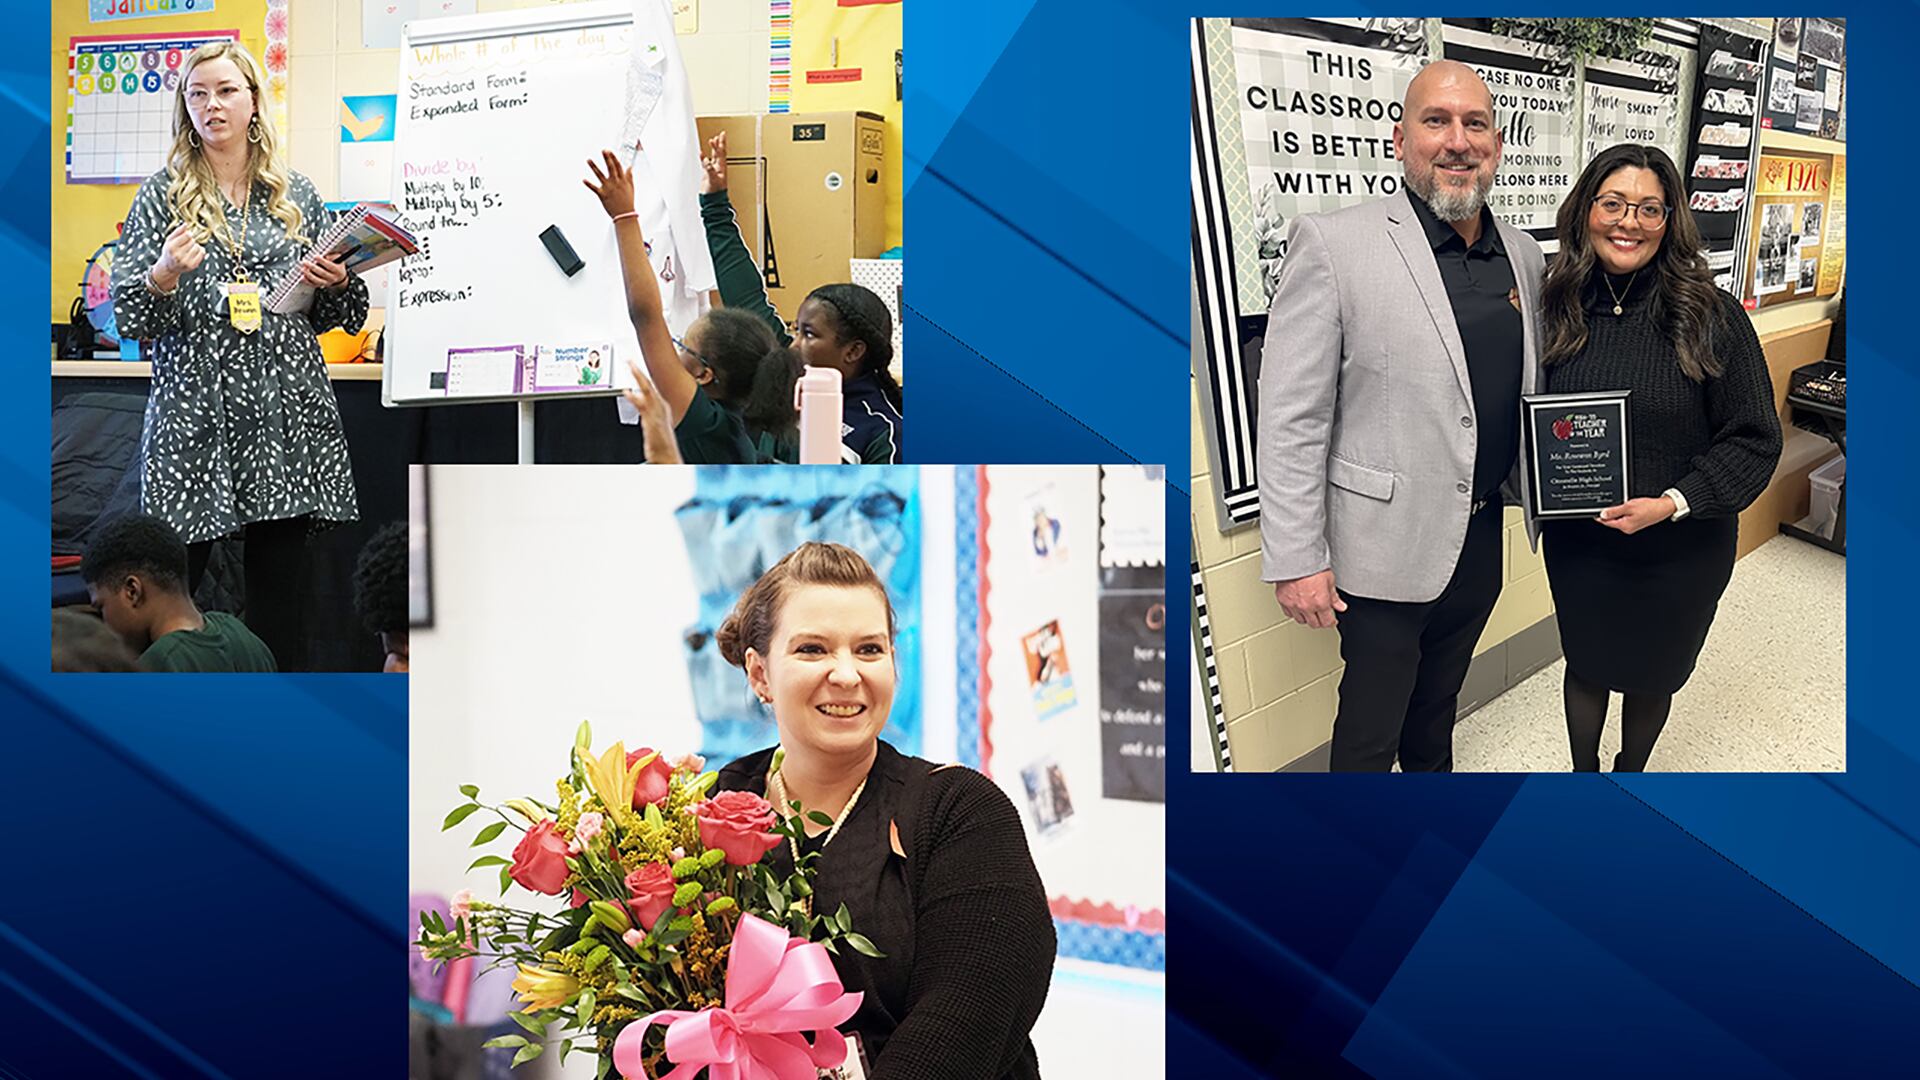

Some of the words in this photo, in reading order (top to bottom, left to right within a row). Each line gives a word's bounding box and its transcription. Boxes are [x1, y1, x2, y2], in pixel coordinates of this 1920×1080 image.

[415, 44, 466, 65] Whole
[476, 42, 489, 56] #
[502, 36, 517, 53] of
[534, 36, 562, 50] the
[82, 58, 89, 69] 5
[104, 55, 112, 67] 6
[147, 53, 155, 66] 8
[170, 52, 177, 65] 9
[1306, 50, 1373, 81] THIS
[125, 77, 135, 90] 14
[147, 75, 158, 89] 15
[1476, 68, 1510, 85] CASE
[1515, 74, 1533, 87] NO
[1537, 77, 1561, 91] ONE
[410, 79, 475, 100] Standard
[410, 98, 479, 120] Expanded
[489, 93, 528, 110] Form:
[1246, 86, 1404, 122] CLASSROO
[1491, 93, 1518, 108] YOU
[1522, 96, 1563, 112] TODAY
[1627, 103, 1659, 116] SMART
[799, 129, 812, 138] 35
[1493, 110, 1536, 147] ello
[1625, 129, 1655, 140] LOVED
[1272, 130, 1300, 154] IS
[1312, 133, 1395, 158] BETTE
[1504, 154, 1562, 167] MORNING
[404, 160, 450, 178] Divide
[1787, 161, 1828, 191] 1920s
[1273, 172, 1352, 194] WITH
[1362, 175, 1405, 194] YO
[1495, 174, 1536, 186] ELONG
[1539, 174, 1569, 186] HERE
[405, 181, 445, 197] Multiply
[405, 196, 457, 216] Multiply
[460, 193, 479, 217] by
[1517, 194, 1557, 206] DOING
[402, 216, 436, 232] Round
[400, 286, 472, 308] Expression:
[555, 347, 589, 355] Number
[555, 354, 584, 362] Strings
[1574, 419, 1607, 428] TEACHER
[1584, 428, 1605, 438] YEAR
[1113, 708, 1151, 724] defend
[1119, 740, 1143, 756] and
